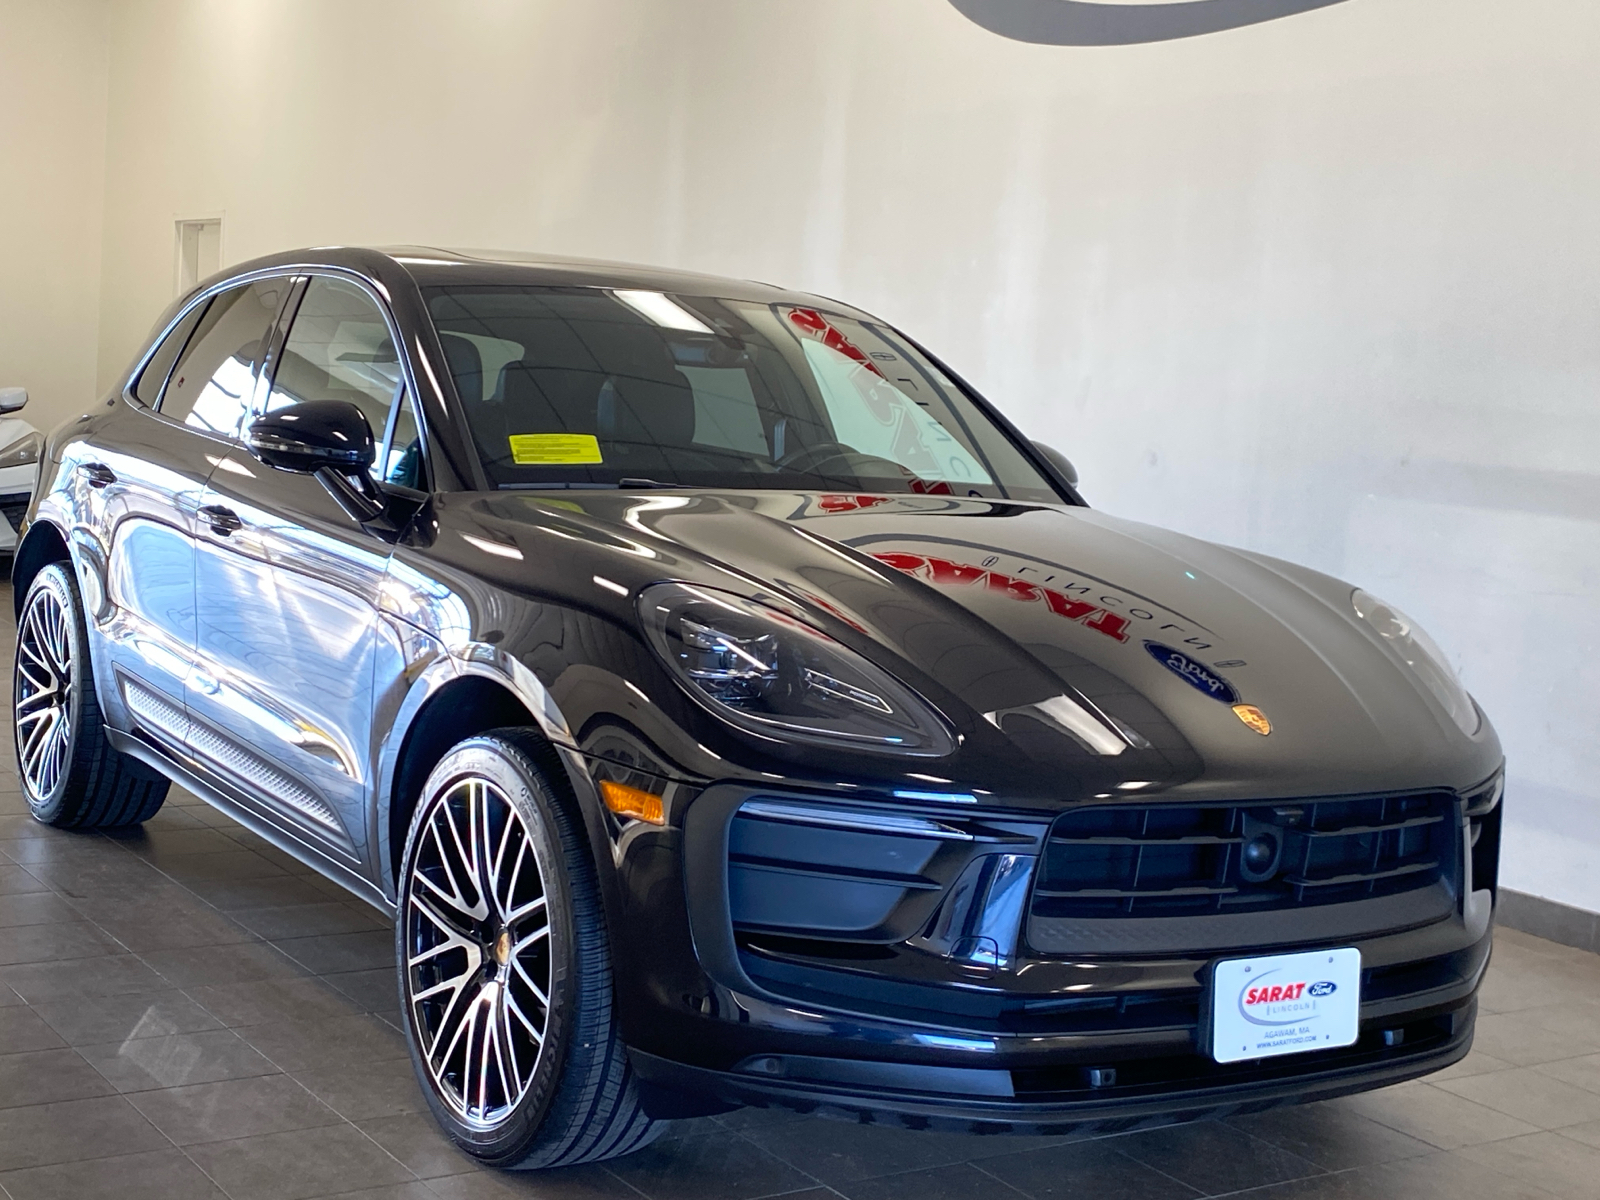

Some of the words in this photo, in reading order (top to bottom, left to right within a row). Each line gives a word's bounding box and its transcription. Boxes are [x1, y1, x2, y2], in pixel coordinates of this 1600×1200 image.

[1245, 982, 1306, 1005] SARAT
[1310, 981, 1334, 996] Ford
[1273, 1003, 1310, 1014] LINCOLN
[1264, 1028, 1298, 1039] AGAWAM,
[1299, 1026, 1310, 1035] MA
[1256, 1035, 1317, 1049] WWW.SARATFORD.COM
